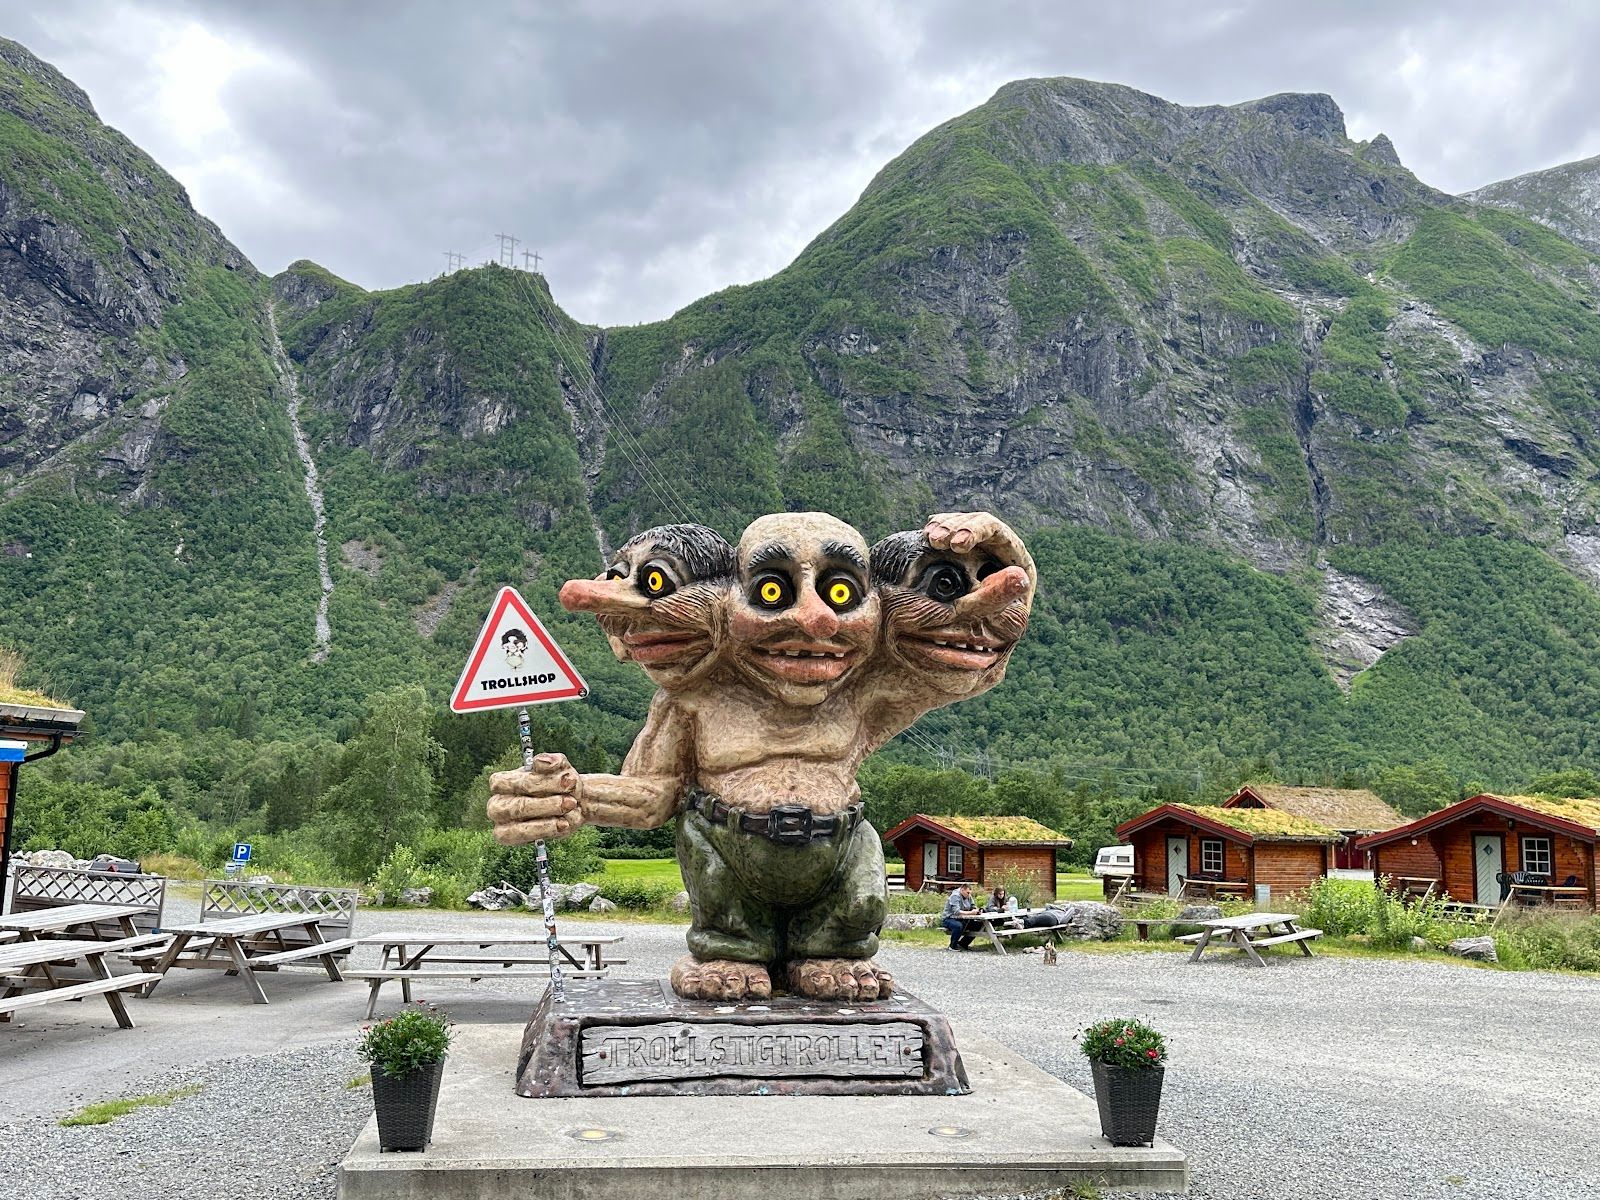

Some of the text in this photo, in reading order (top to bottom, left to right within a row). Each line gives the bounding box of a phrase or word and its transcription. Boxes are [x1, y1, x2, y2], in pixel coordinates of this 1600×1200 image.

[480, 673, 556, 690] TROLLSHOP
[237, 846, 247, 858] P
[602, 1036, 906, 1067] TROLLSTIGTROLLET
